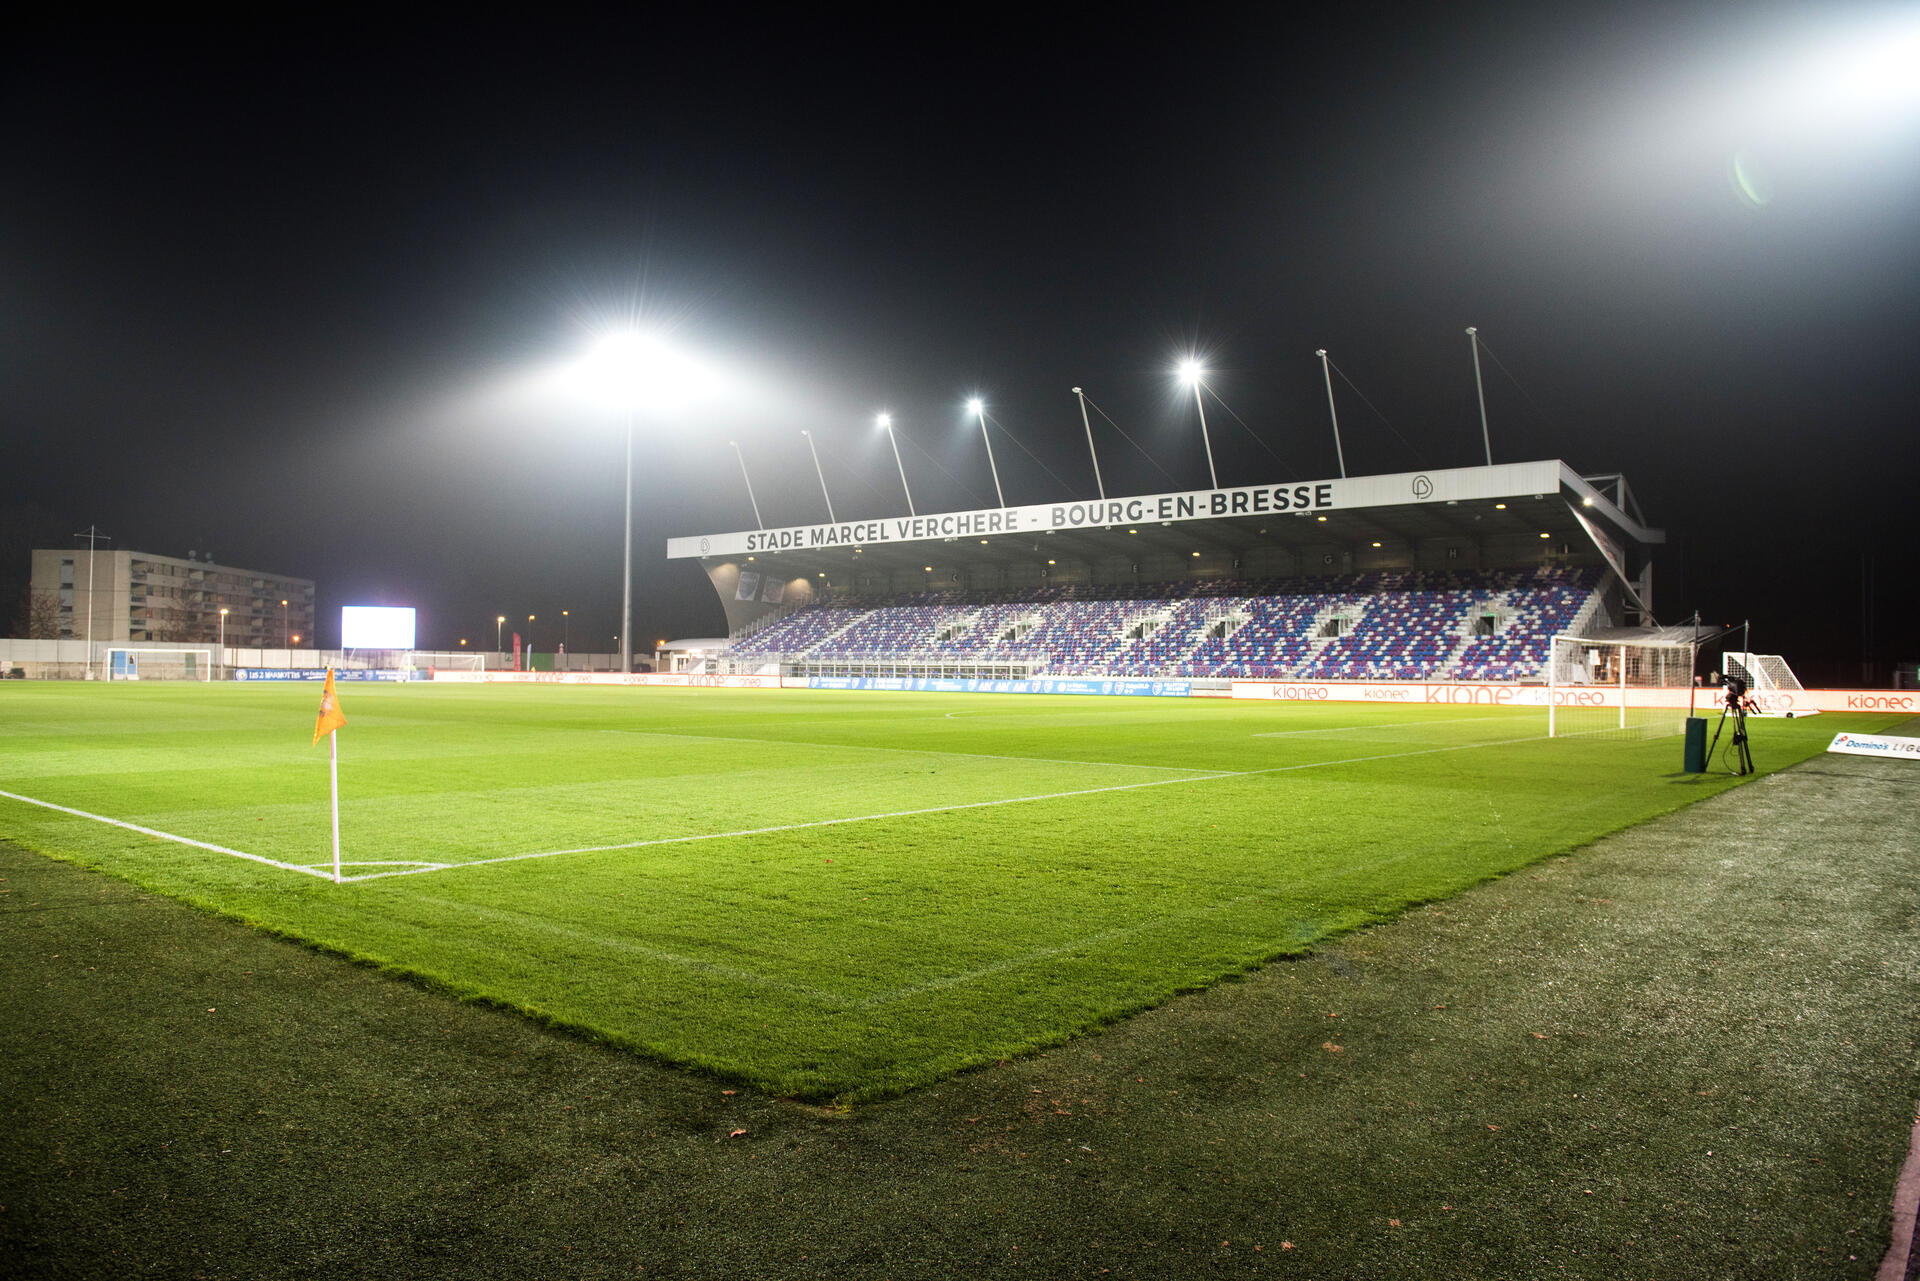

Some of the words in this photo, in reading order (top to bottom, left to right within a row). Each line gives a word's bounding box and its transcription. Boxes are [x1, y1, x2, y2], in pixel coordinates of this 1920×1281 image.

[746, 529, 804, 551] STADE
[810, 523, 890, 546] MARCEL
[897, 510, 1018, 539] VERCHERE
[1051, 483, 1333, 527] BOURG-EN-BRESSE
[1324, 554, 1334, 565] G
[1448, 547, 1457, 560] H
[1272, 684, 1328, 700] kioneo
[1364, 687, 1410, 701] kioneo
[1847, 694, 1914, 710] kioneo
[1846, 739, 1889, 750] Domino's
